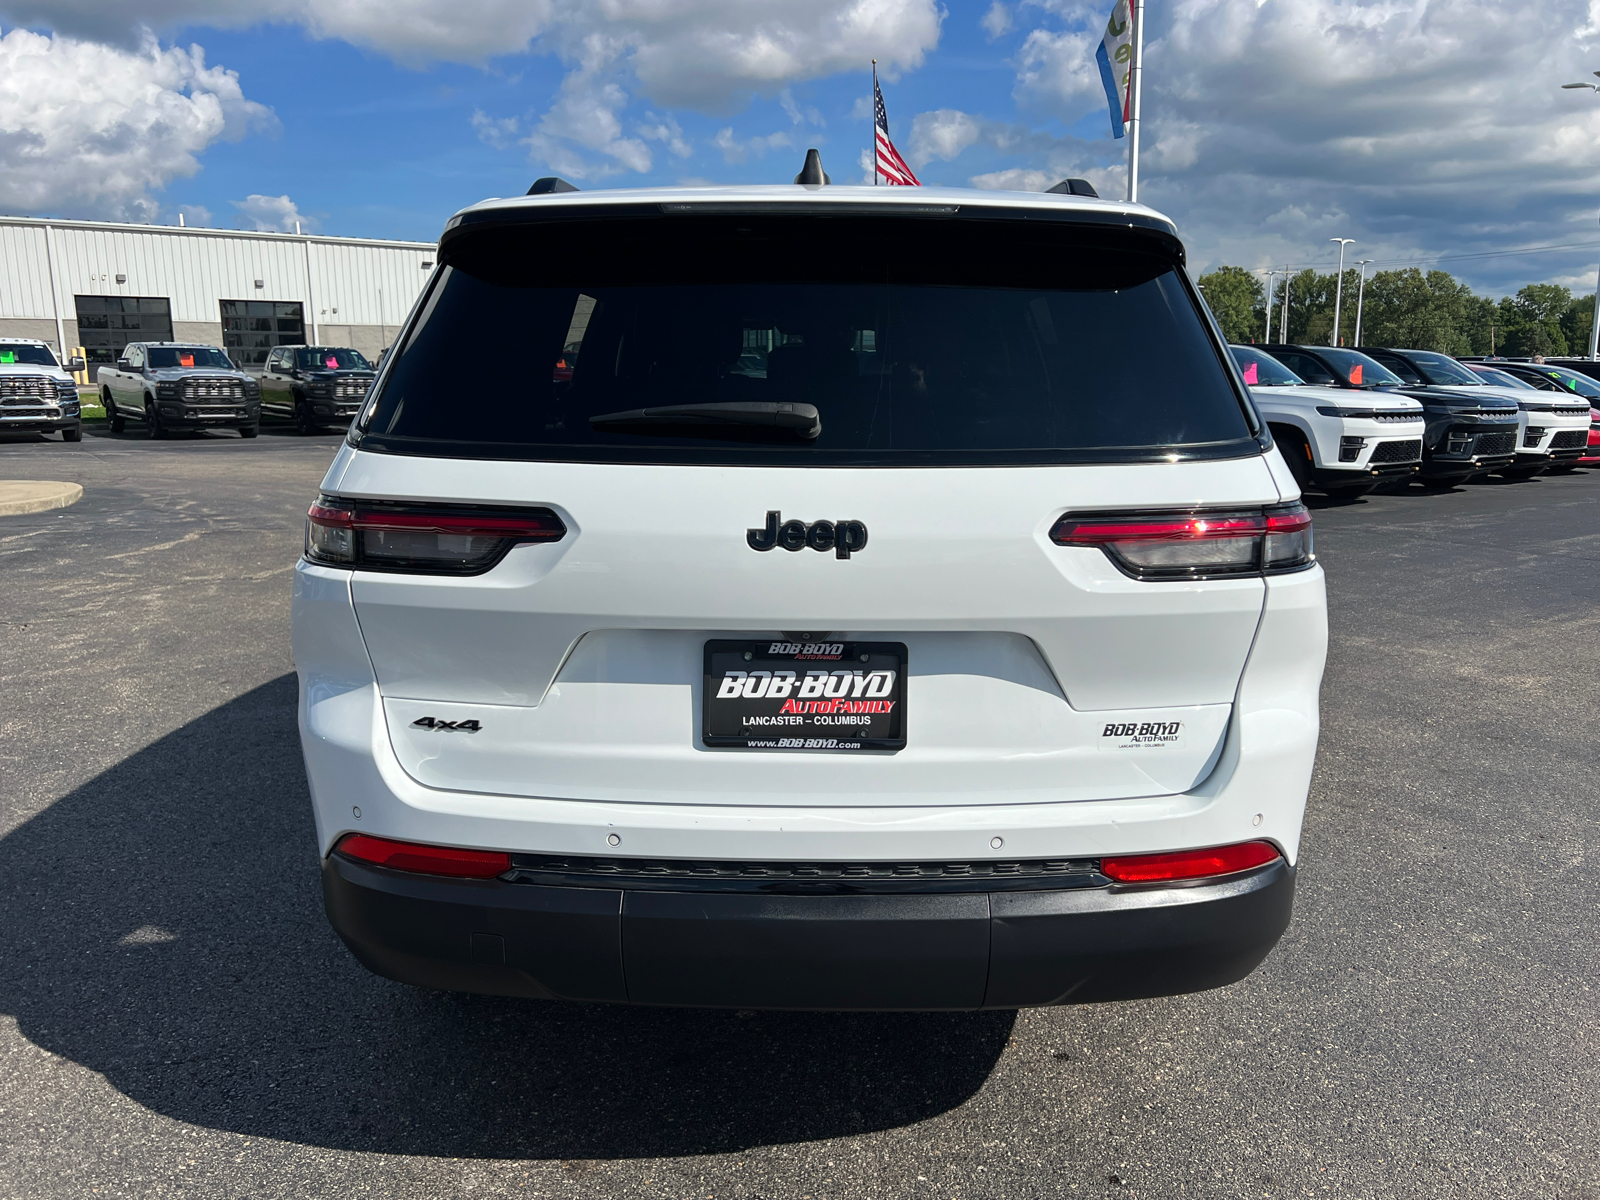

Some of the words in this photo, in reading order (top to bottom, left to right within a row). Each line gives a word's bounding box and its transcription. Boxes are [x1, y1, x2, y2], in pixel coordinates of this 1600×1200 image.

[747, 510, 868, 560] Jeep
[716, 670, 897, 698] BOB-BOYD
[412, 716, 483, 731] 4x4
[742, 716, 803, 726] LANCASTER
[814, 715, 871, 725] COLUMBUS
